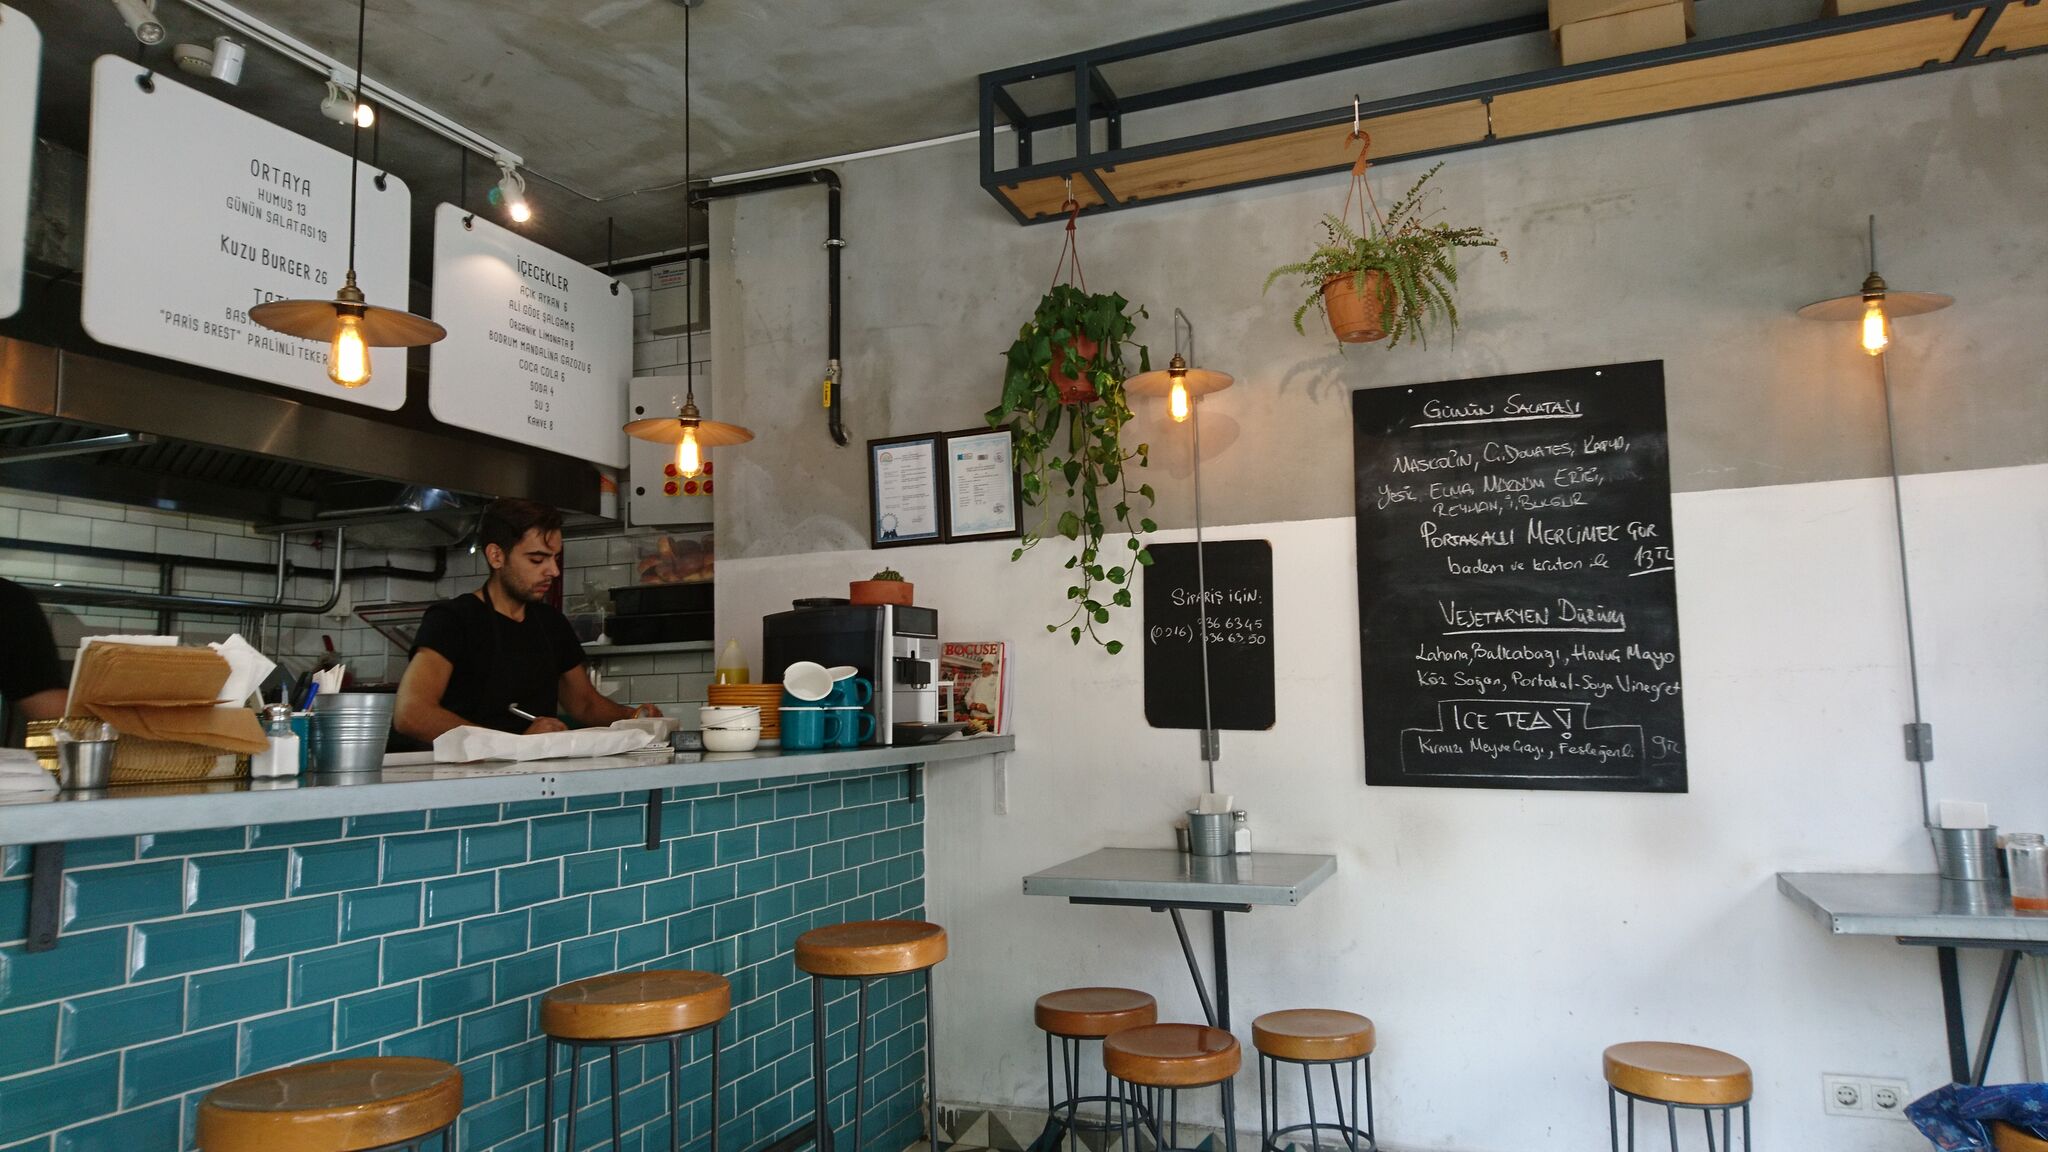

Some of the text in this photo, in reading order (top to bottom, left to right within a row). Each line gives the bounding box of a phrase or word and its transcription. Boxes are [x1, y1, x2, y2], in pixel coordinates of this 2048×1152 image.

[250, 159, 311, 197] ORTAYA
[258, 188, 306, 216] HUMUS 13
[226, 196, 327, 243] GÜNÜN SALATASI 19
[220, 234, 328, 284] KUZU BURGER 26
[519, 359, 538, 374] COCA
[540, 366, 558, 380] COLA
[534, 400, 543, 410] SU
[1448, 556, 1504, 574] badem
[1533, 556, 1582, 571] kruton
[1439, 600, 1548, 628] VEJETARYEN
[946, 644, 998, 656] BOCUSE
[1626, 644, 1676, 670] Mayo
[1454, 705, 1489, 730] ICE
